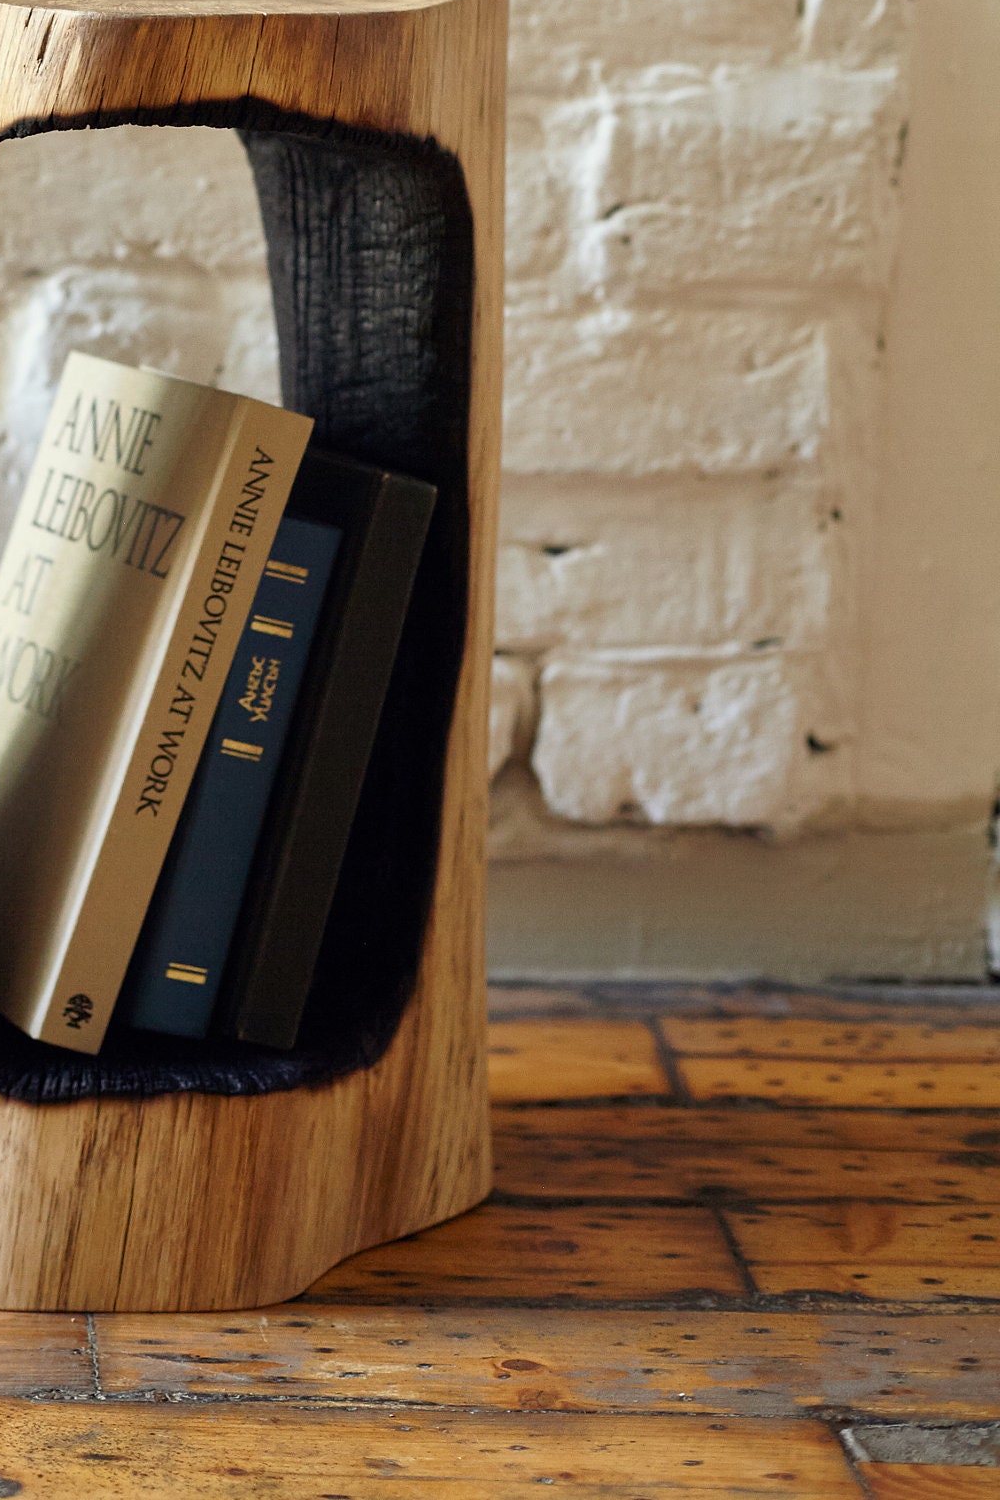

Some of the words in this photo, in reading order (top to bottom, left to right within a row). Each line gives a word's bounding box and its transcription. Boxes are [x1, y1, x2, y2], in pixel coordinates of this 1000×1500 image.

[54, 391, 162, 476] ANNIE
[32, 468, 186, 579] LEIBOVITZ
[229, 445, 275, 537] ANNIE
[3, 553, 54, 617] AT
[181, 540, 246, 682] LEIBOVITZ
[168, 683, 197, 724] AT
[134, 729, 185, 818] WORK
